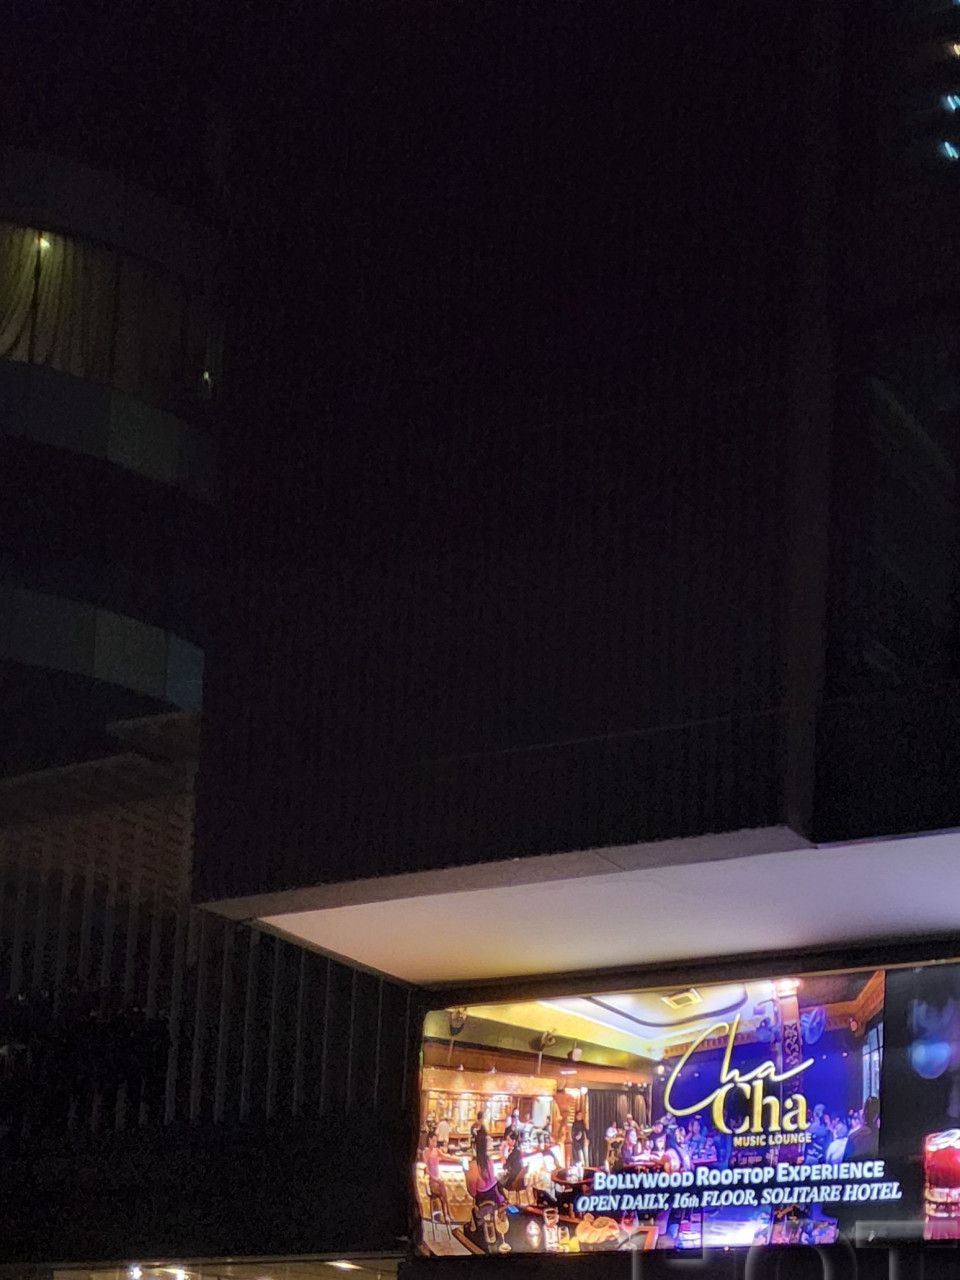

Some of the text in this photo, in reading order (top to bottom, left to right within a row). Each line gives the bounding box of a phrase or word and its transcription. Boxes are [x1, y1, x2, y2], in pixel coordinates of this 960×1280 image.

[664, 1013, 815, 1117] Cha
[712, 1079, 811, 1135] Cha
[732, 1132, 813, 1147] MUSIC LOUNGE
[576, 1195, 621, 1213] OPEN
[621, 1193, 670, 1211] DAILY,
[701, 1188, 759, 1207] FLOOR,
[760, 1185, 842, 1205] SOLITARE
[843, 1182, 903, 1201] HOTEL
